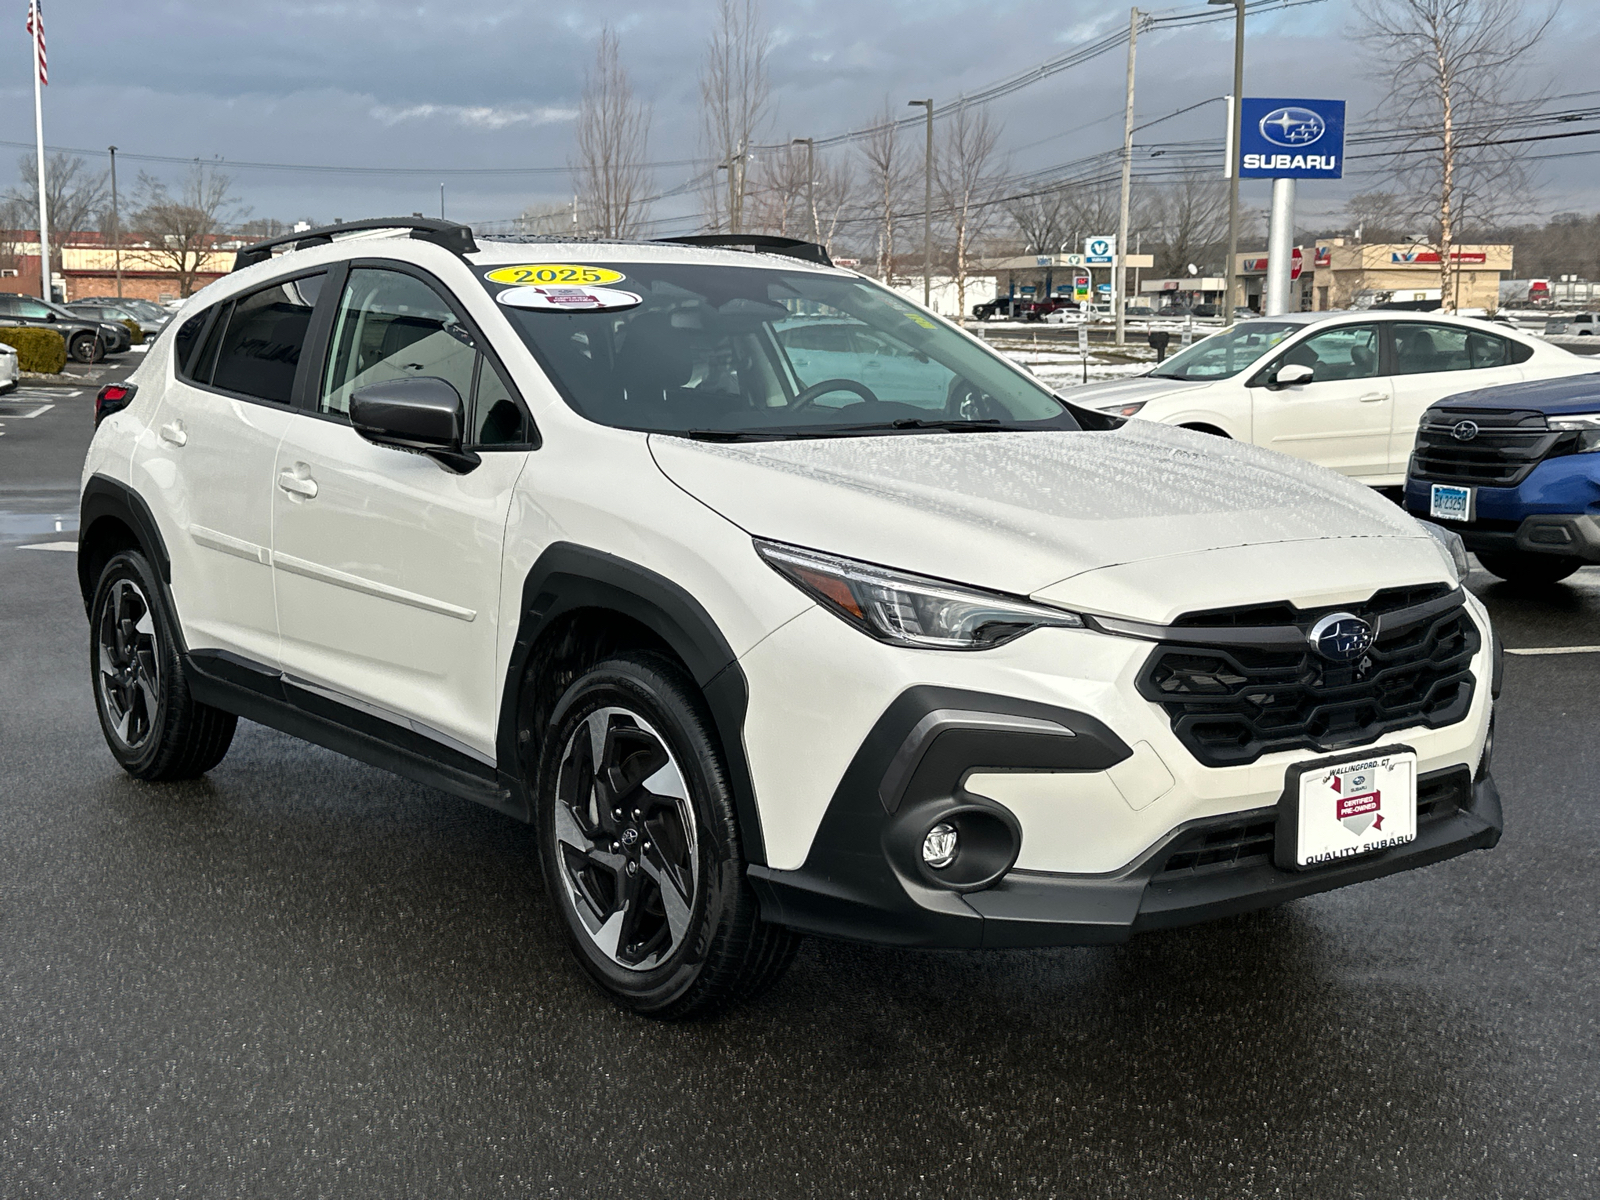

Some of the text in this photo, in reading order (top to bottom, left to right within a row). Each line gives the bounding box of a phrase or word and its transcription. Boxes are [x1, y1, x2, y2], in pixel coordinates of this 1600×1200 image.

[1243, 154, 1335, 170] SUBARU
[1291, 257, 1302, 270] TOP
[514, 269, 601, 282] 2025
[1381, 758, 1390, 767] CT
[1343, 796, 1374, 808] CERTIFIED
[1341, 803, 1376, 815] PRE-OWNED
[1305, 834, 1413, 865] QUALITY SUBARU
